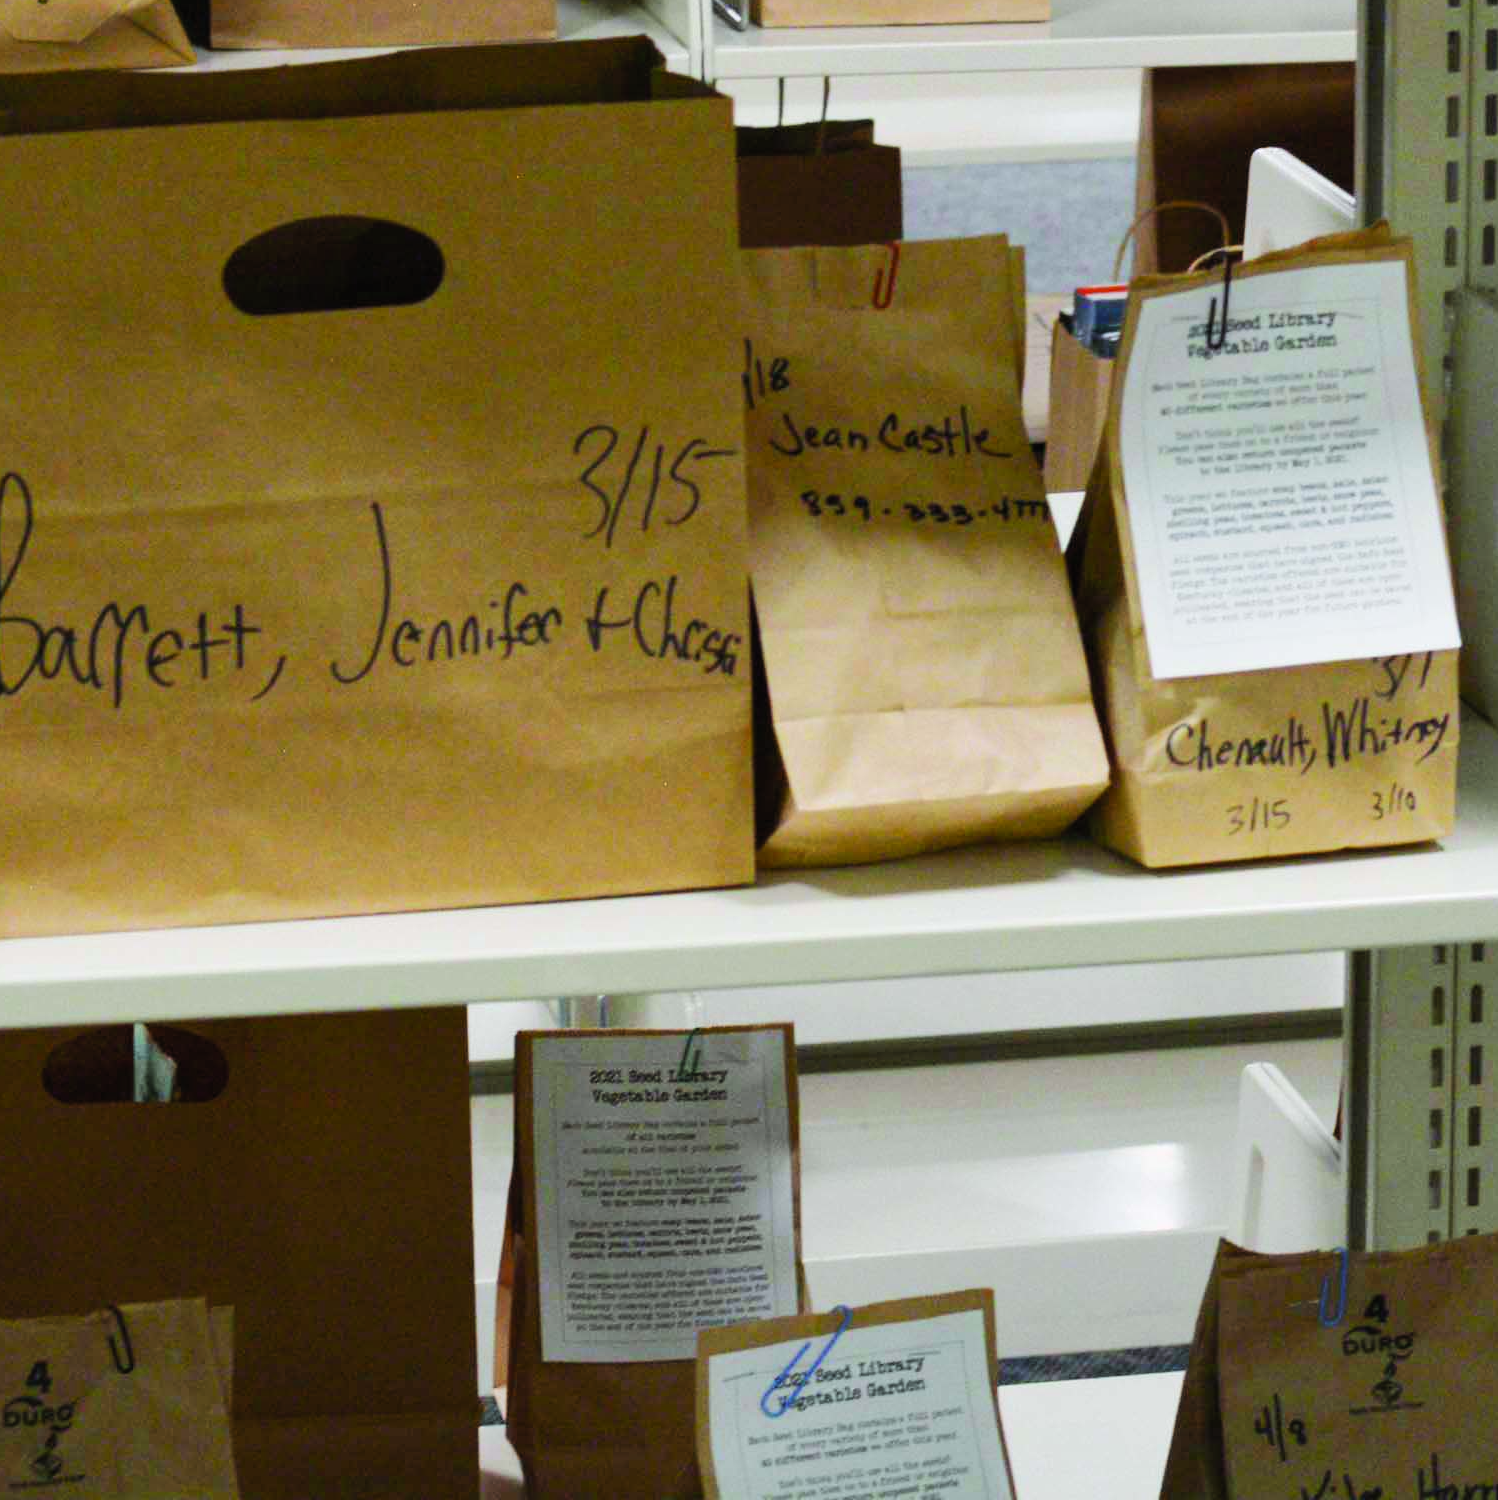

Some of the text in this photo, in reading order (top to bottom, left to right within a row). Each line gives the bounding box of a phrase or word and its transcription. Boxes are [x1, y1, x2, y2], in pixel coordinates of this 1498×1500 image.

[1268, 311, 1337, 330] Library
[1274, 332, 1338, 352] Garden
[769, 404, 1013, 458] Jean Castle
[573, 423, 738, 548] 3/15
[331, 501, 564, 684] Jennifer
[1225, 796, 1292, 837] 3/15
[1362, 1293, 1389, 1325] 4
[1342, 1332, 1415, 1357] DURO
[25, 1361, 53, 1393] 4
[815, 1364, 853, 1383] Seed
[857, 1356, 925, 1378] Library
[866, 1377, 927, 1399] Garden
[3, 1403, 75, 1428] DURO
